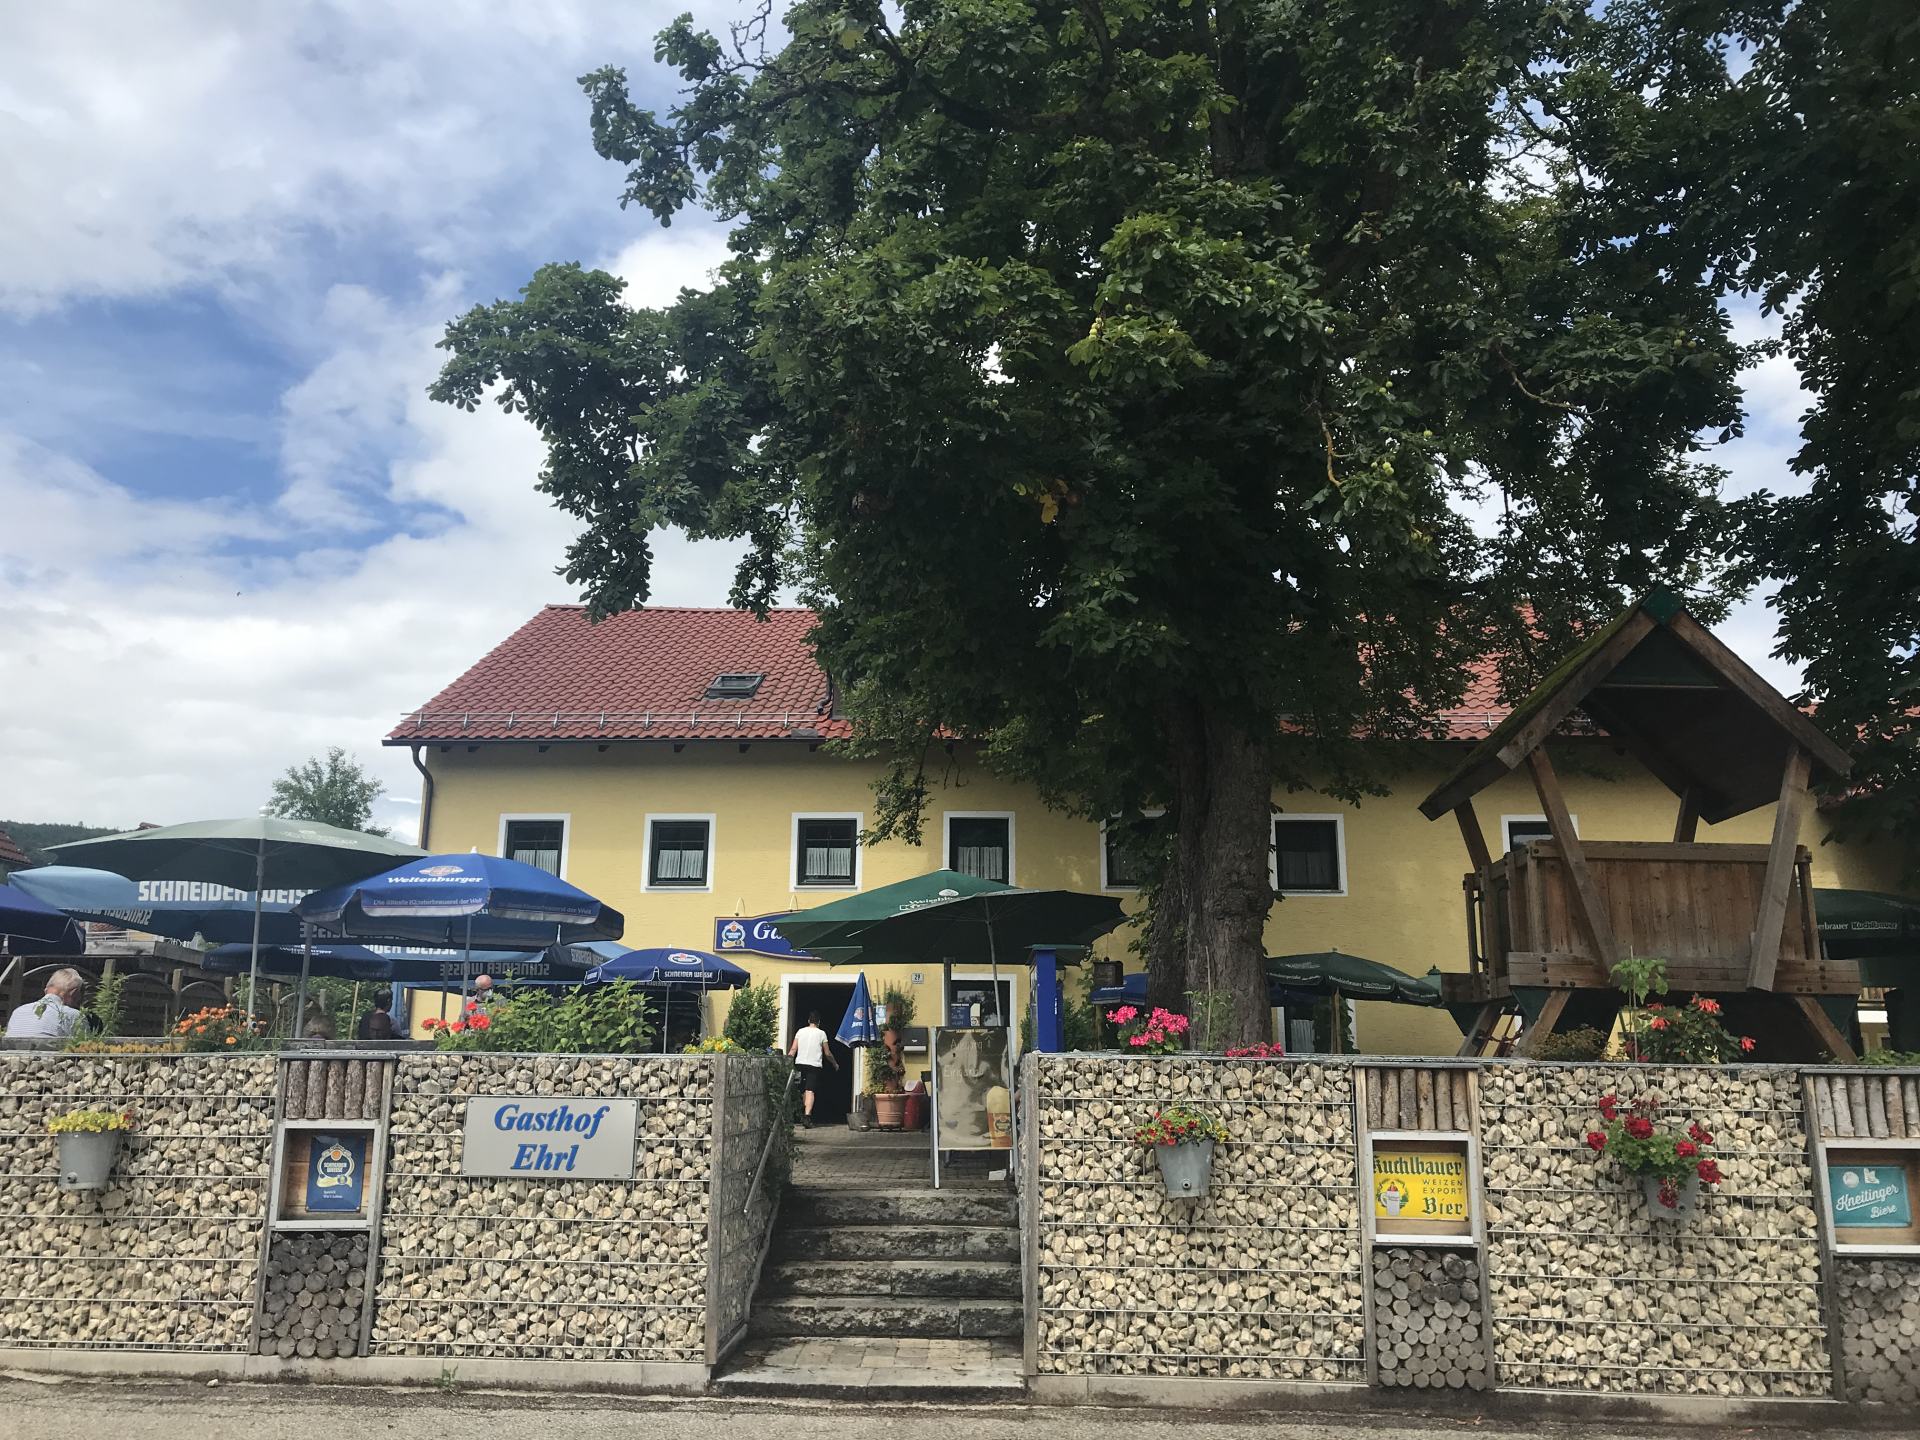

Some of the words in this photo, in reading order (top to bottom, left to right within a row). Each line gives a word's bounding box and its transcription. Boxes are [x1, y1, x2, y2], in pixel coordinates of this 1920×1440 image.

[387, 876, 483, 884] Weltenburger
[494, 1104, 610, 1139] Gasthof
[510, 1143, 580, 1171] Ehrl
[1421, 1196, 1463, 1215] Bier
[1836, 1184, 1899, 1211] Kneitinger
[1870, 1205, 1898, 1218] Biere
